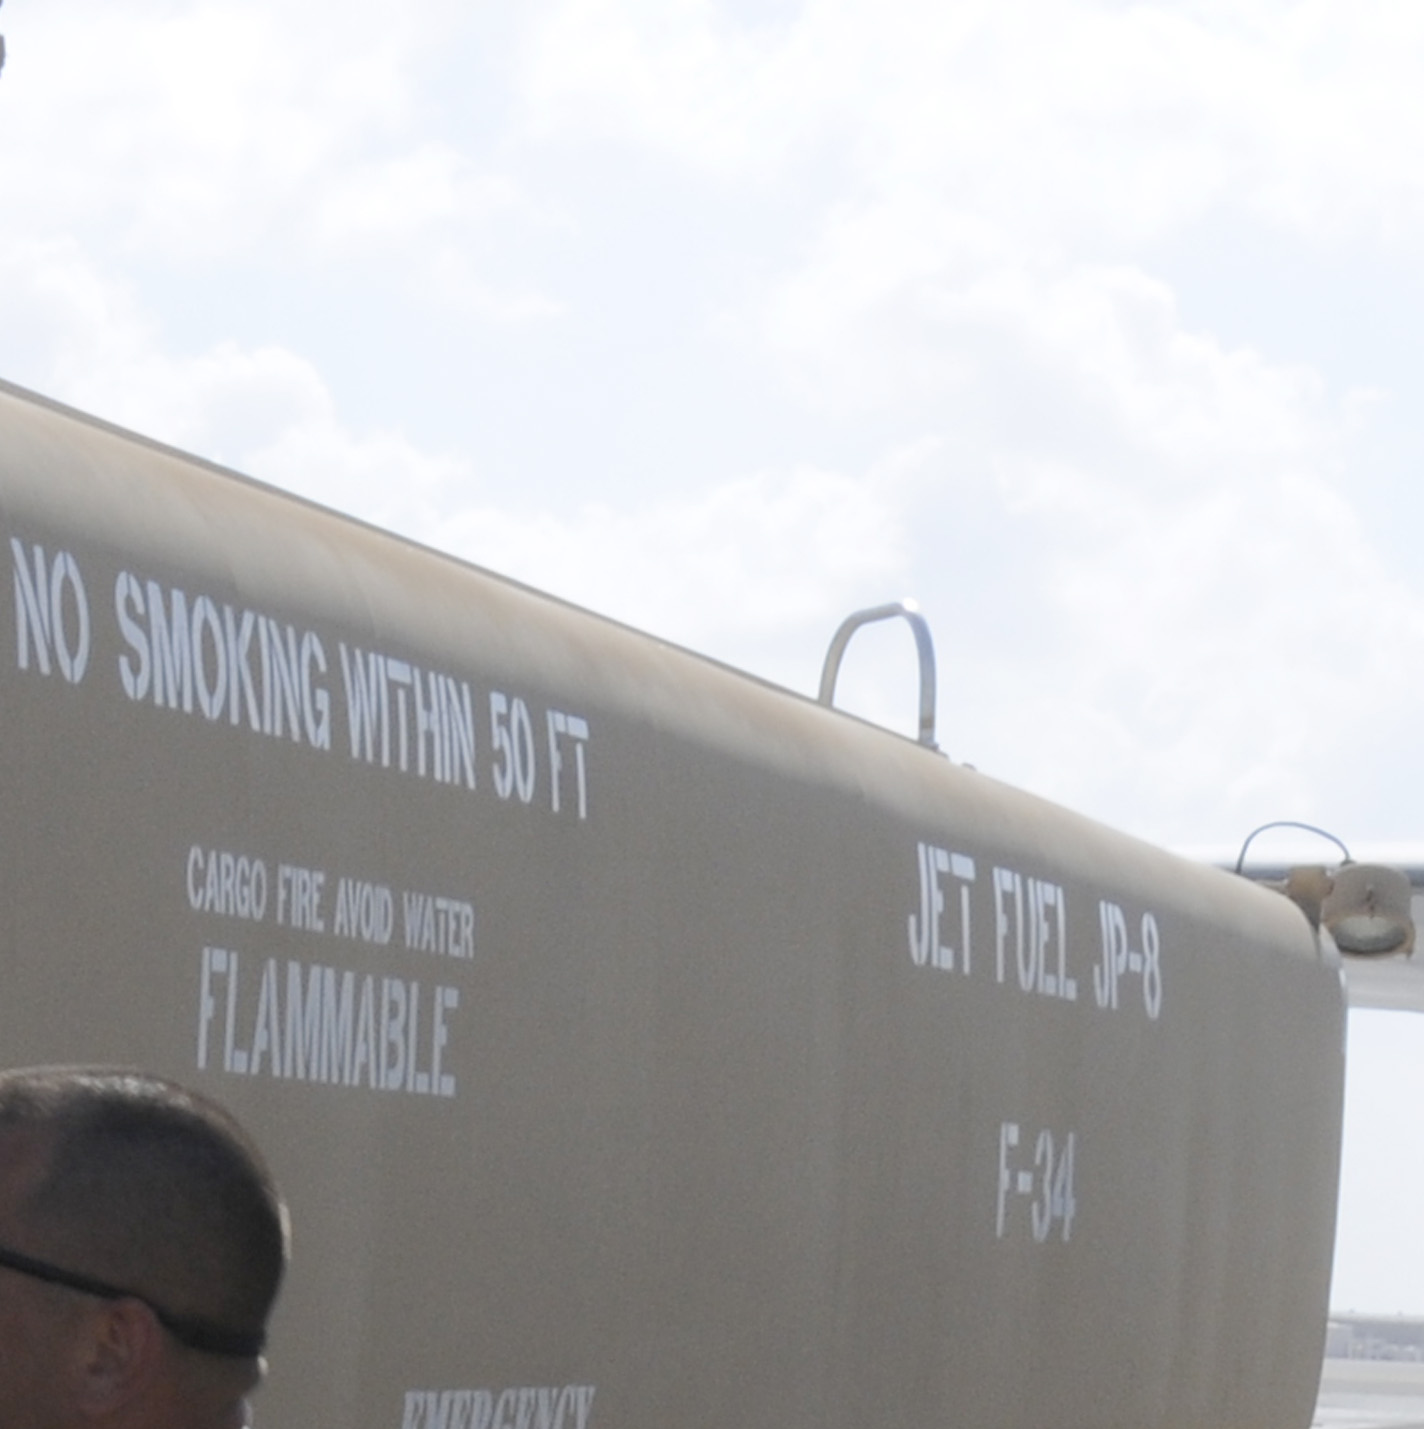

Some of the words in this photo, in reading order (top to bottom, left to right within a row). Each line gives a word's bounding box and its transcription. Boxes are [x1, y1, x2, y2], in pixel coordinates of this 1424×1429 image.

[11, 536, 91, 685] NO
[116, 570, 330, 751] SMOKING
[339, 641, 476, 791] WITHIN
[491, 690, 535, 804] 50
[547, 709, 590, 820] FT
[187, 845, 267, 922] CARGO
[277, 863, 325, 933] FIRE
[334, 876, 393, 945] AVOID
[403, 891, 475, 959] WATER
[908, 841, 976, 976] JET
[992, 865, 1078, 1001] FUEL
[1094, 899, 1163, 1020] JP-8
[197, 946, 460, 1098] FLAMMABLE
[995, 1121, 1077, 1243] F-34
